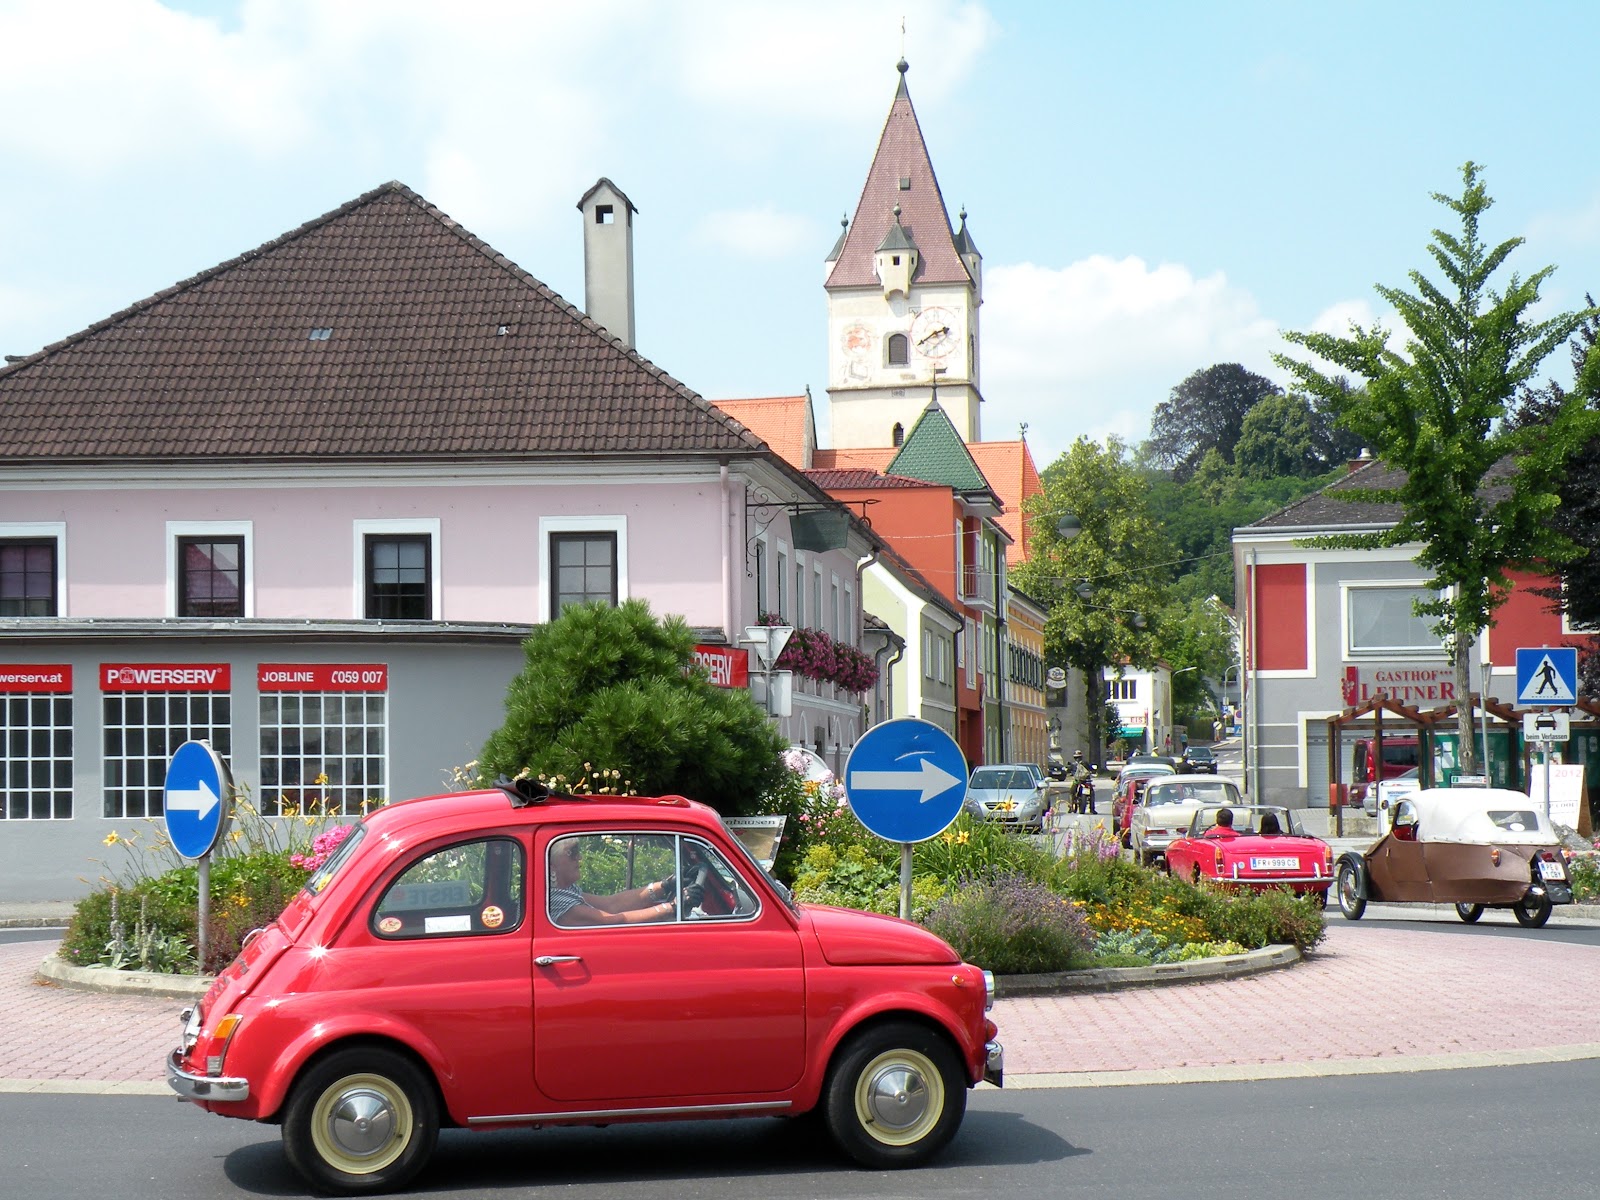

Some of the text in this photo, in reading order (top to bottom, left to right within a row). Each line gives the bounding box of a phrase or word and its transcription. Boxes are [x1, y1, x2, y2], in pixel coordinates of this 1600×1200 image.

[107, 667, 216, 684] POWERSERV
[262, 671, 383, 683] JOBLINE 059 007
[1375, 671, 1438, 681] GASTHOF
[1361, 682, 1456, 700] LETTNER
[1555, 769, 1582, 778] 2012
